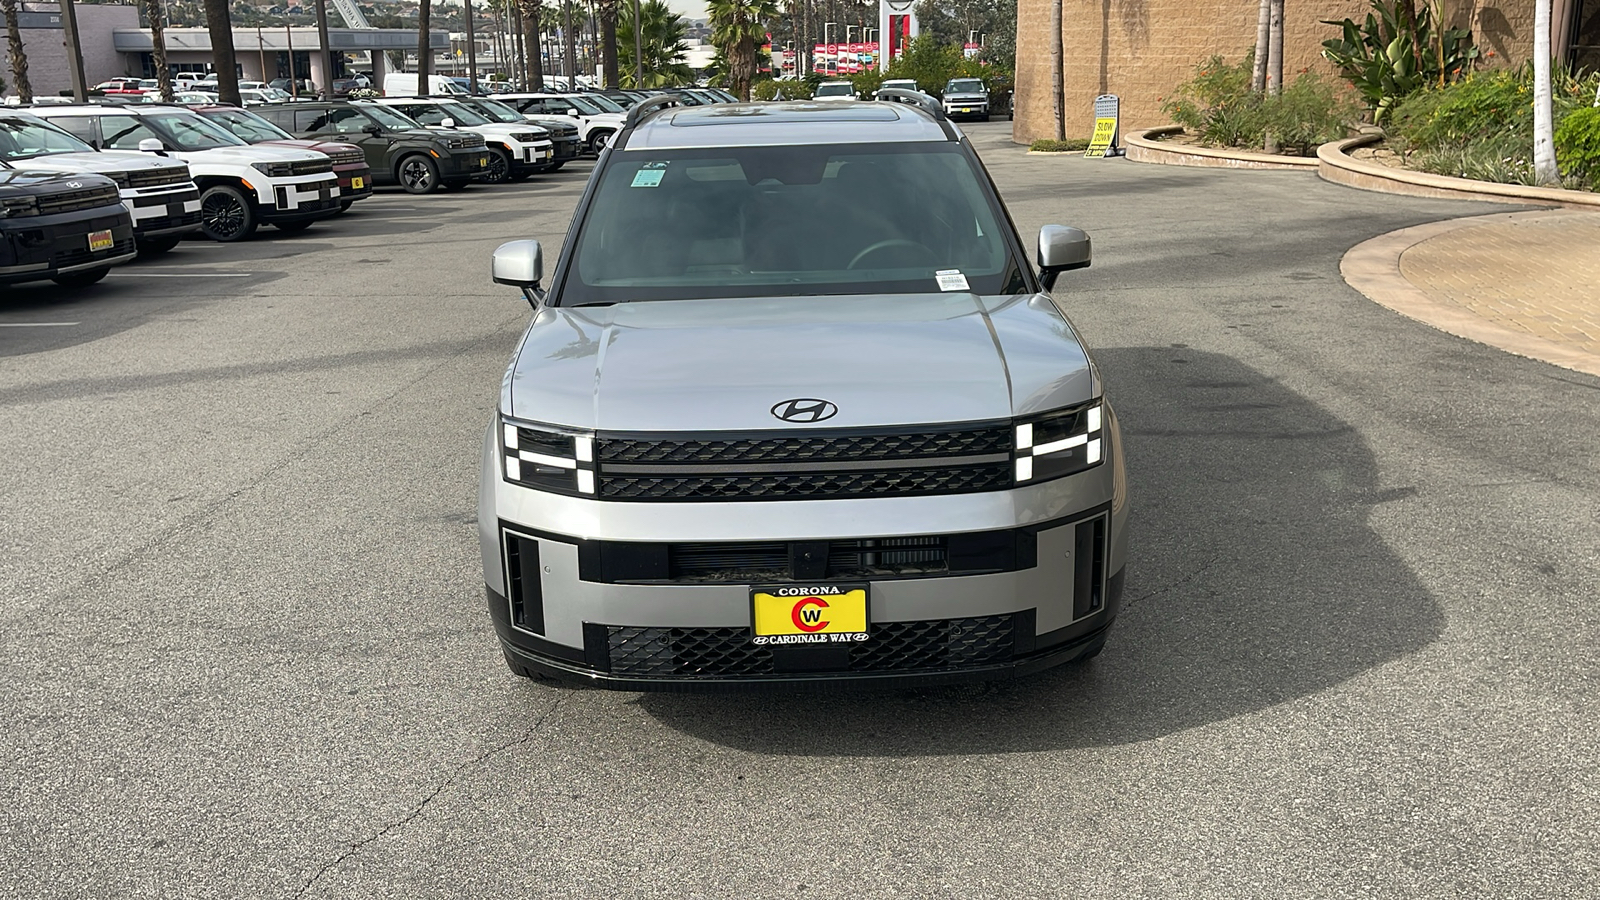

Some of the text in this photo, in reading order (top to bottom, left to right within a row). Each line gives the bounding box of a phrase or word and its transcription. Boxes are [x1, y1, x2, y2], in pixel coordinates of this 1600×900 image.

[1097, 122, 1114, 131] SLOW
[1094, 133, 1112, 142] DOWN
[778, 586, 840, 596] CORONA
[769, 633, 853, 645] CARDINALE WAY
